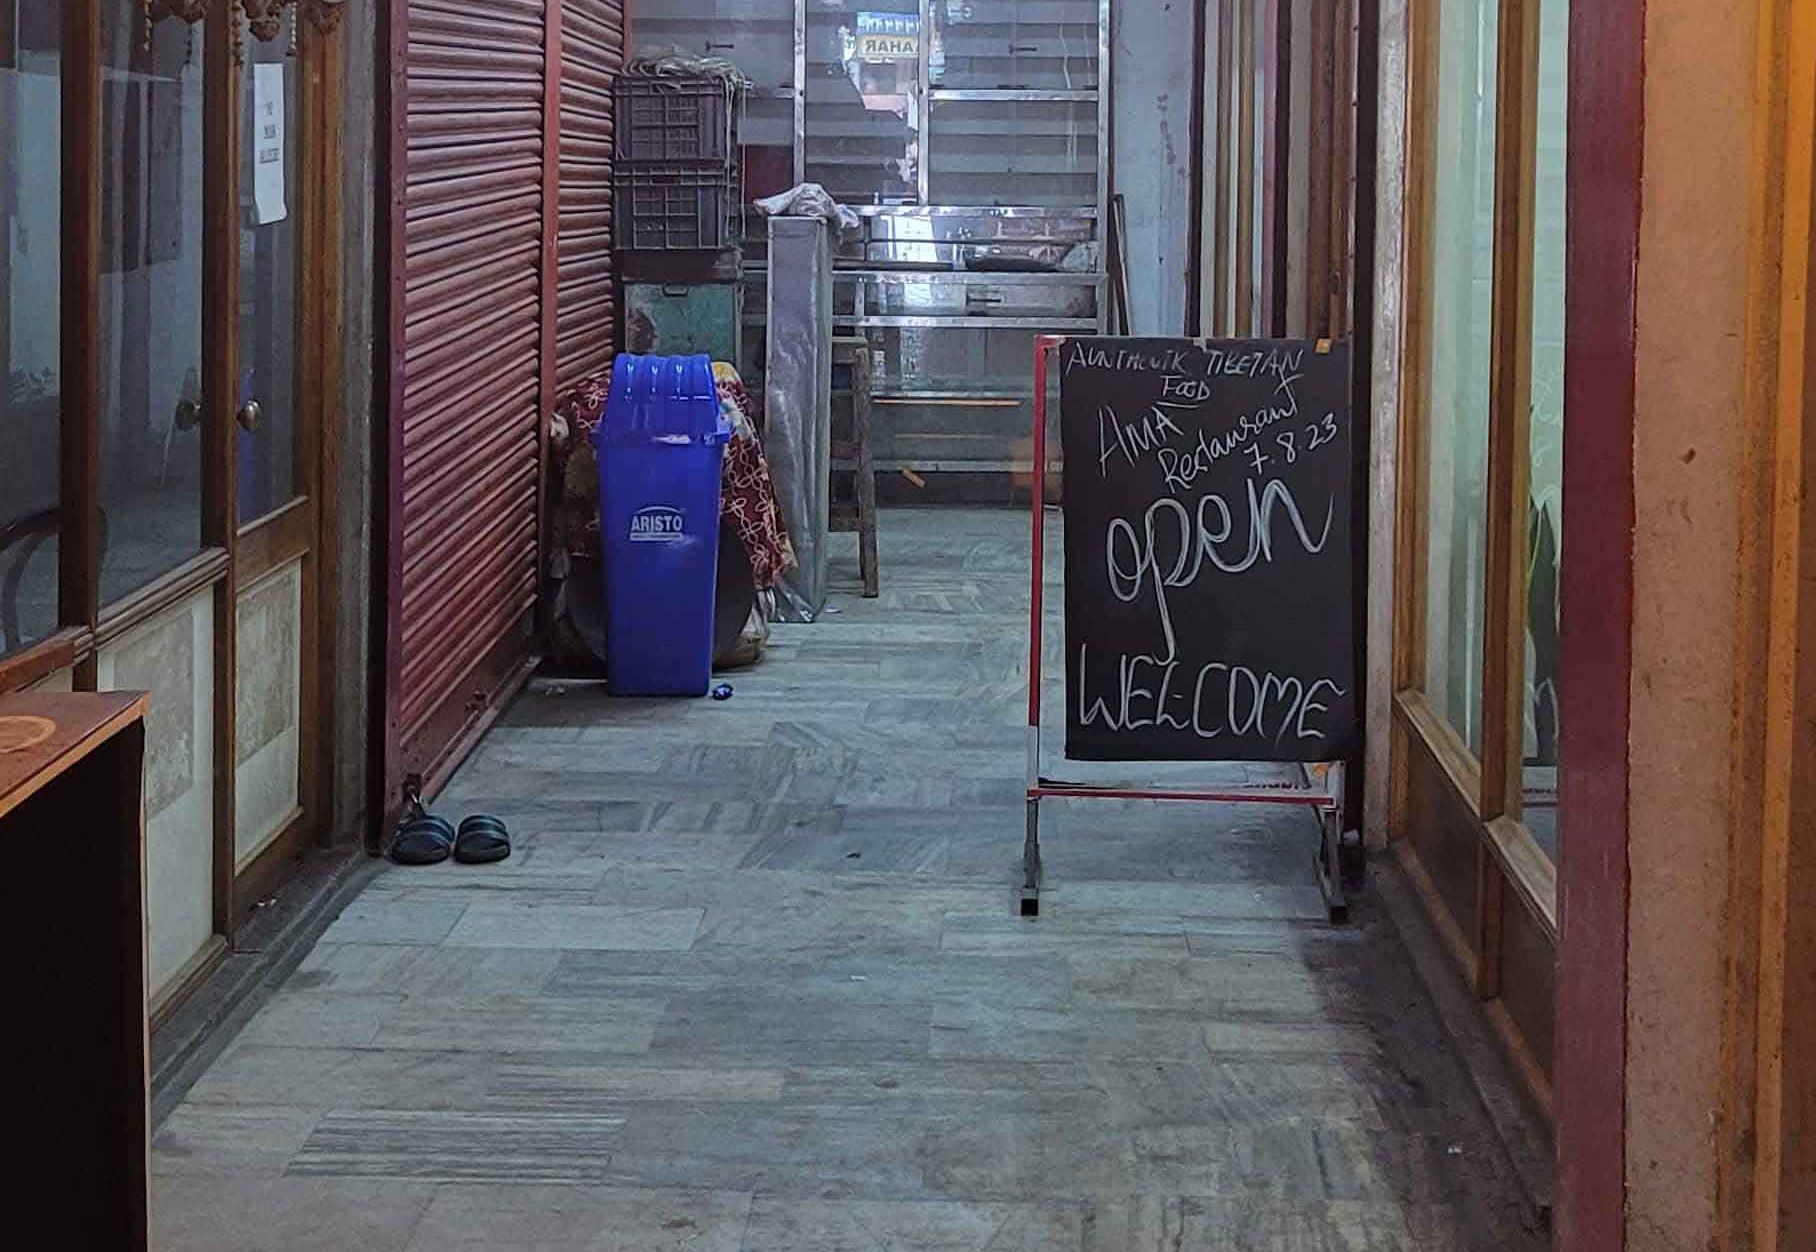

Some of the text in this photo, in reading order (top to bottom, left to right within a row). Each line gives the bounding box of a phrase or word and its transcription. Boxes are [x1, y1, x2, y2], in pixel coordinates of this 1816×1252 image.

[1098, 404, 1184, 479] AMA
[631, 515, 683, 532] ARISTO
[1079, 642, 1346, 741] WELCOME
